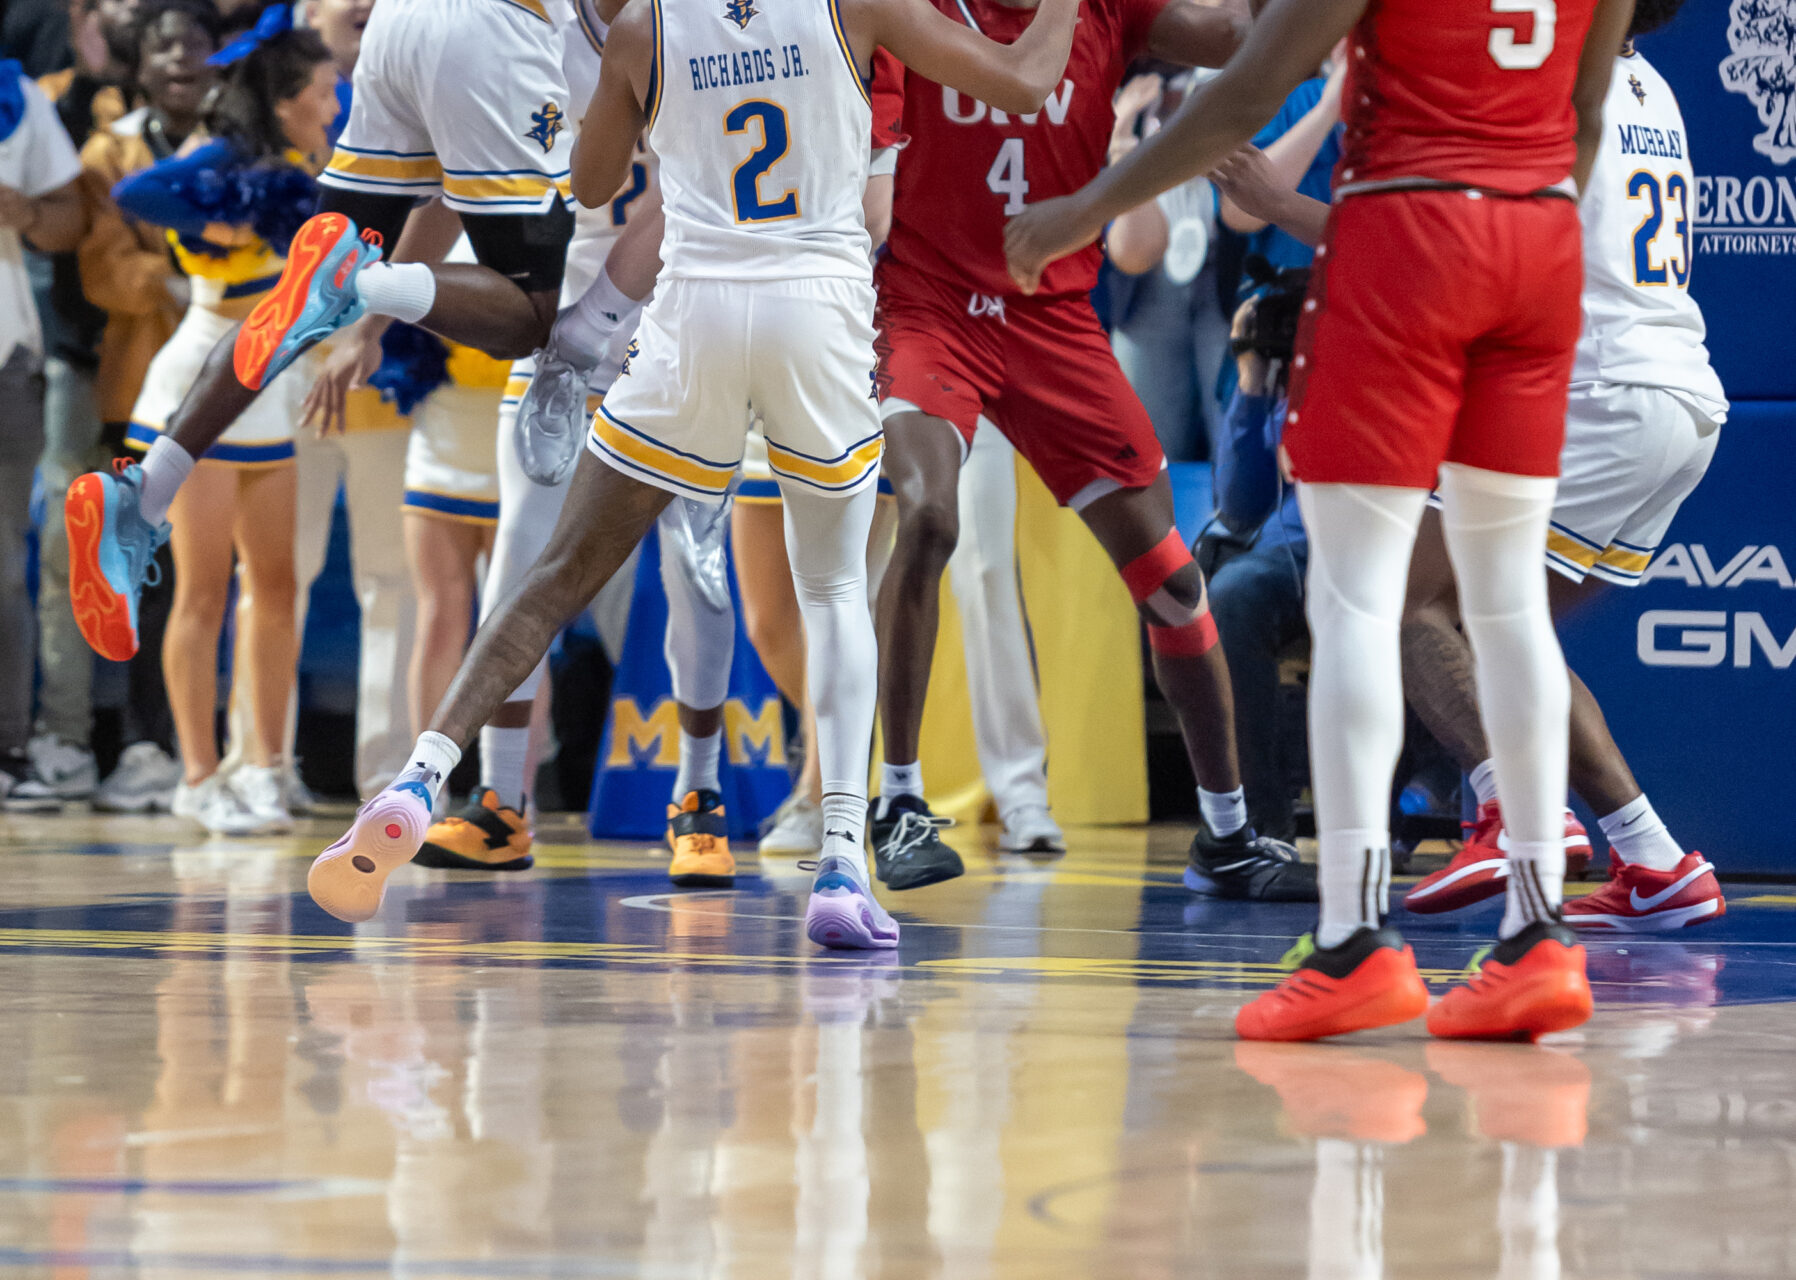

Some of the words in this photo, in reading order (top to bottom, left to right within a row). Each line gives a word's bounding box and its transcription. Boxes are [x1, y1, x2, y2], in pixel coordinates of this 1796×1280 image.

[689, 48, 776, 91] RICHARDS
[782, 44, 809, 79] JR.
[722, 97, 802, 225] 2
[986, 138, 1030, 217] 4
[1618, 124, 1683, 160] MURRAY
[1626, 167, 1690, 289] 23
